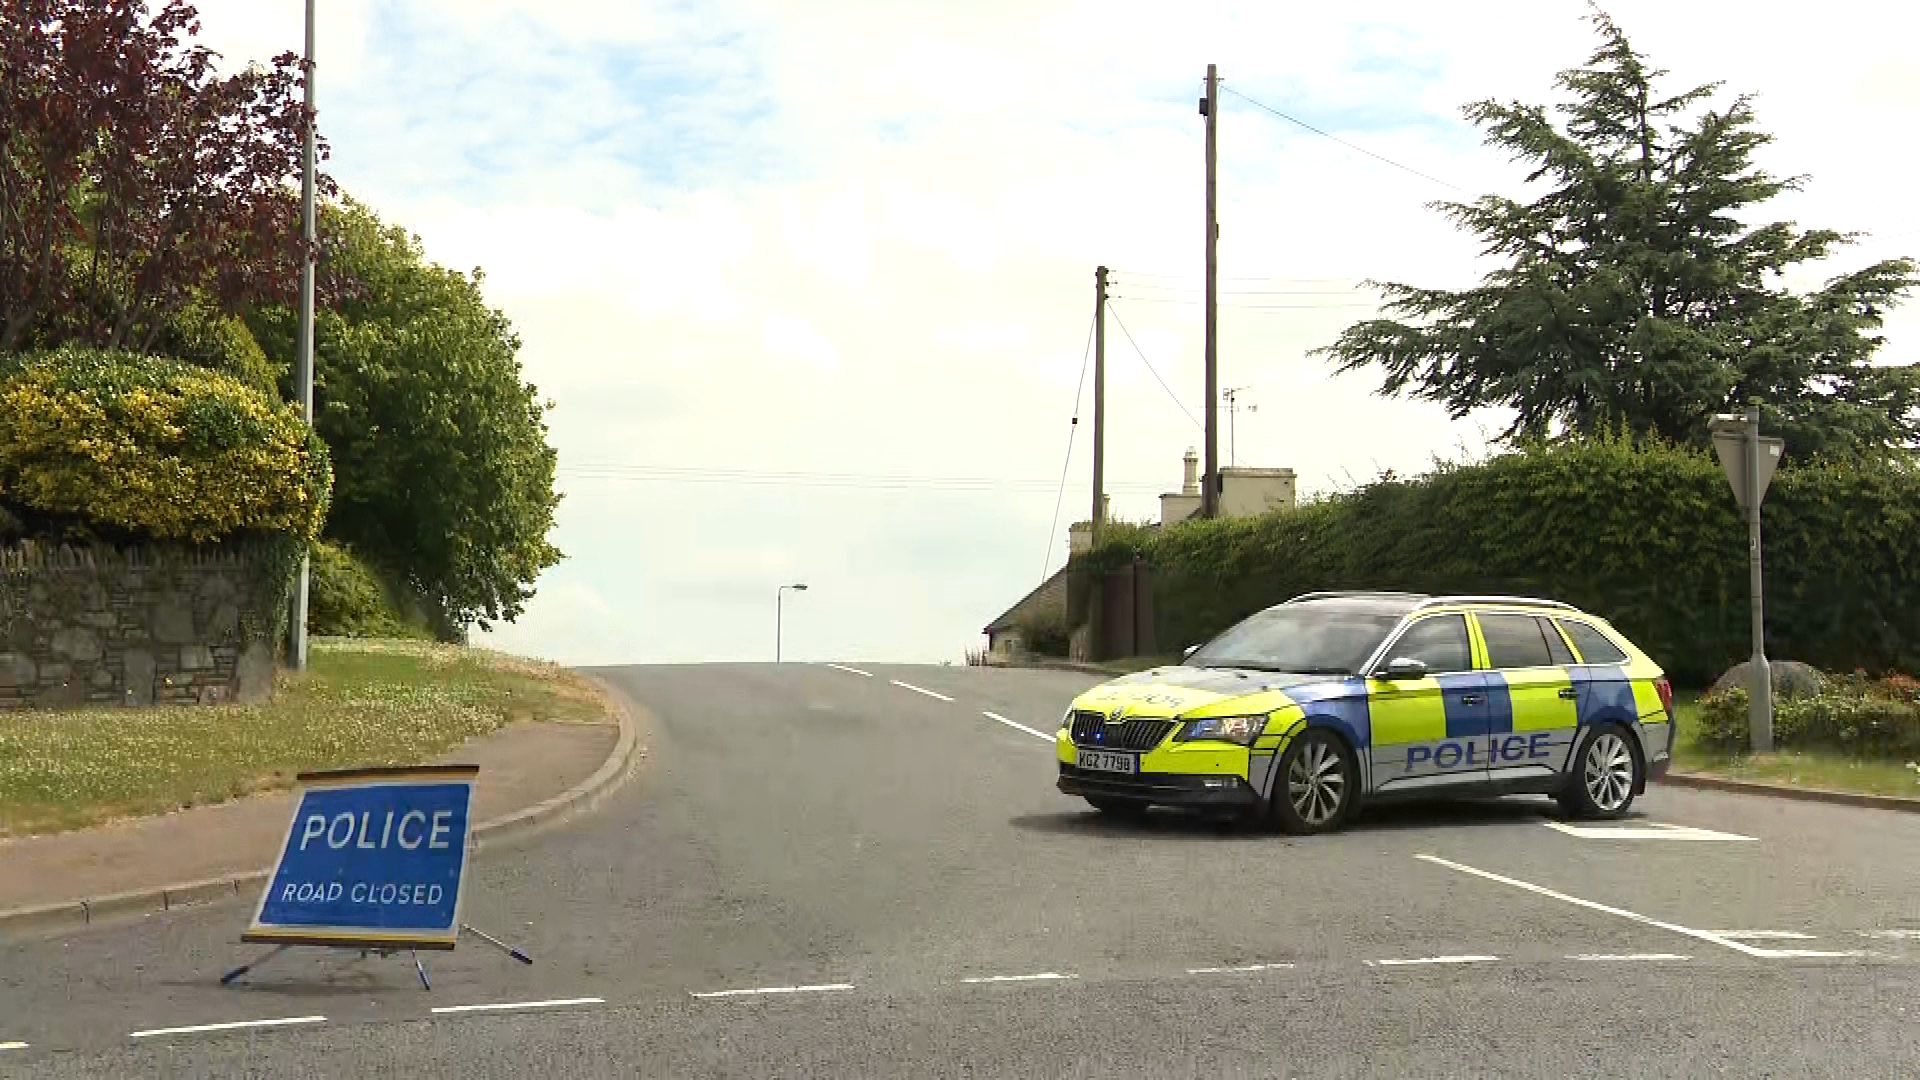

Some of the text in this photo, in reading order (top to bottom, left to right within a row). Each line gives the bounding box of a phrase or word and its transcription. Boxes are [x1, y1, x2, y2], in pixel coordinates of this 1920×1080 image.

[1079, 751, 1100, 769] KGZ
[1405, 733, 1551, 772] POLICE
[299, 810, 452, 851] POLICE
[281, 881, 443, 905] ROAD CLOSED
